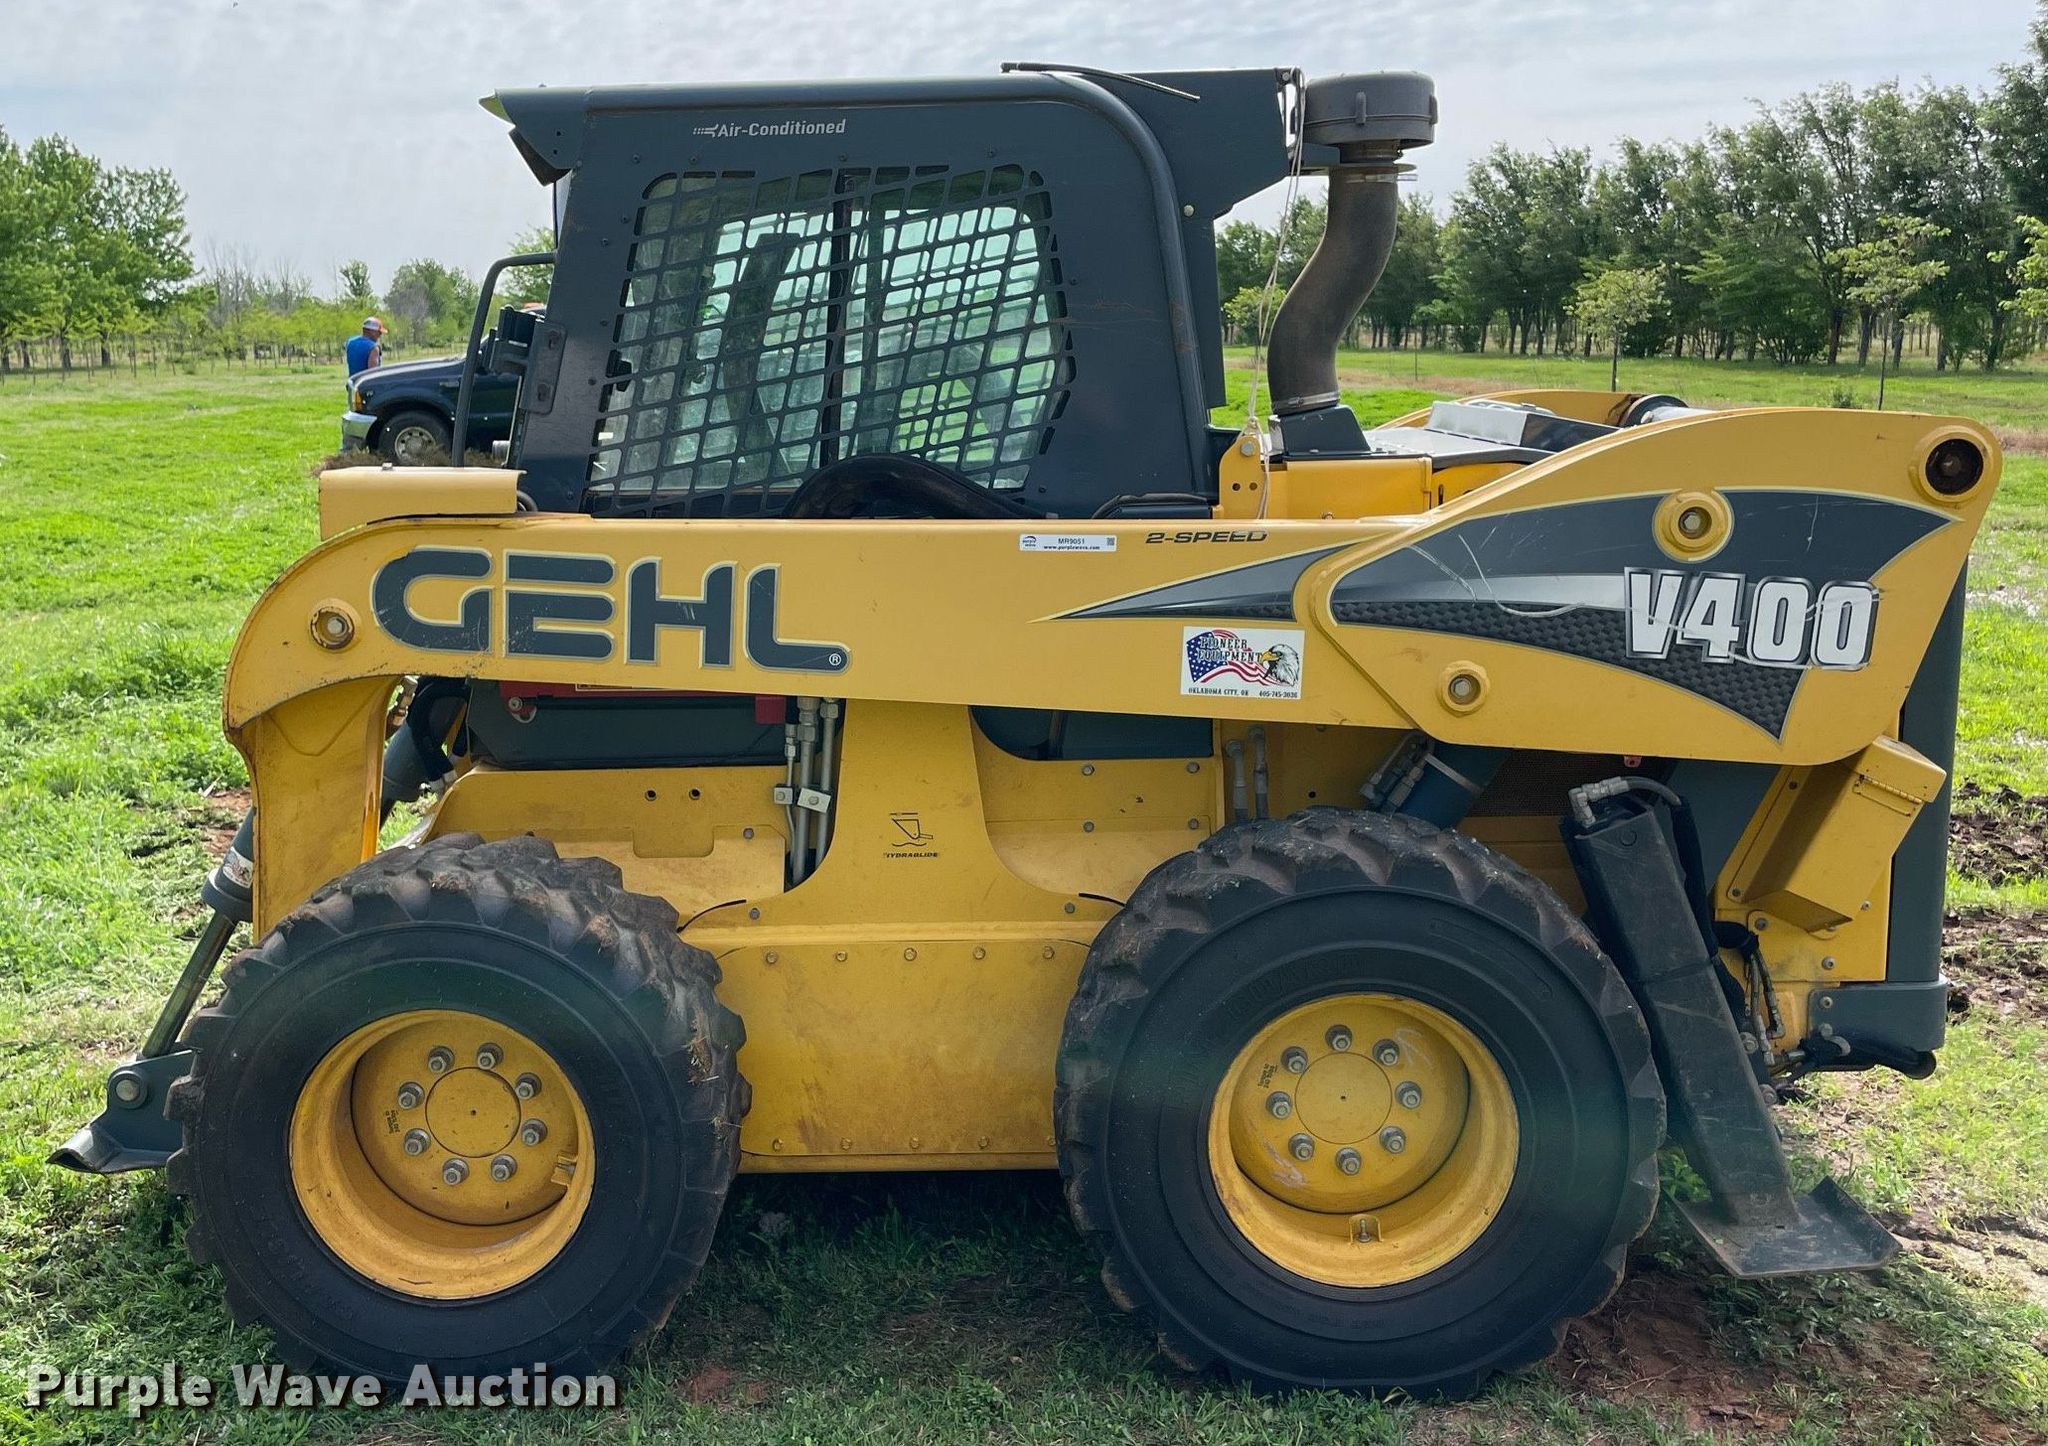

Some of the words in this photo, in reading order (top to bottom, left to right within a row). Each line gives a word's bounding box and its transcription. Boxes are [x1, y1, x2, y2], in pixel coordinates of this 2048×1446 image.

[717, 119, 846, 137] Air-Conditioned
[1145, 531, 1267, 544] 2-SPEED
[1624, 566, 1880, 672] V400
[1200, 636, 1248, 649] PIONEER
[1197, 648, 1263, 662] EQUIPMENT
